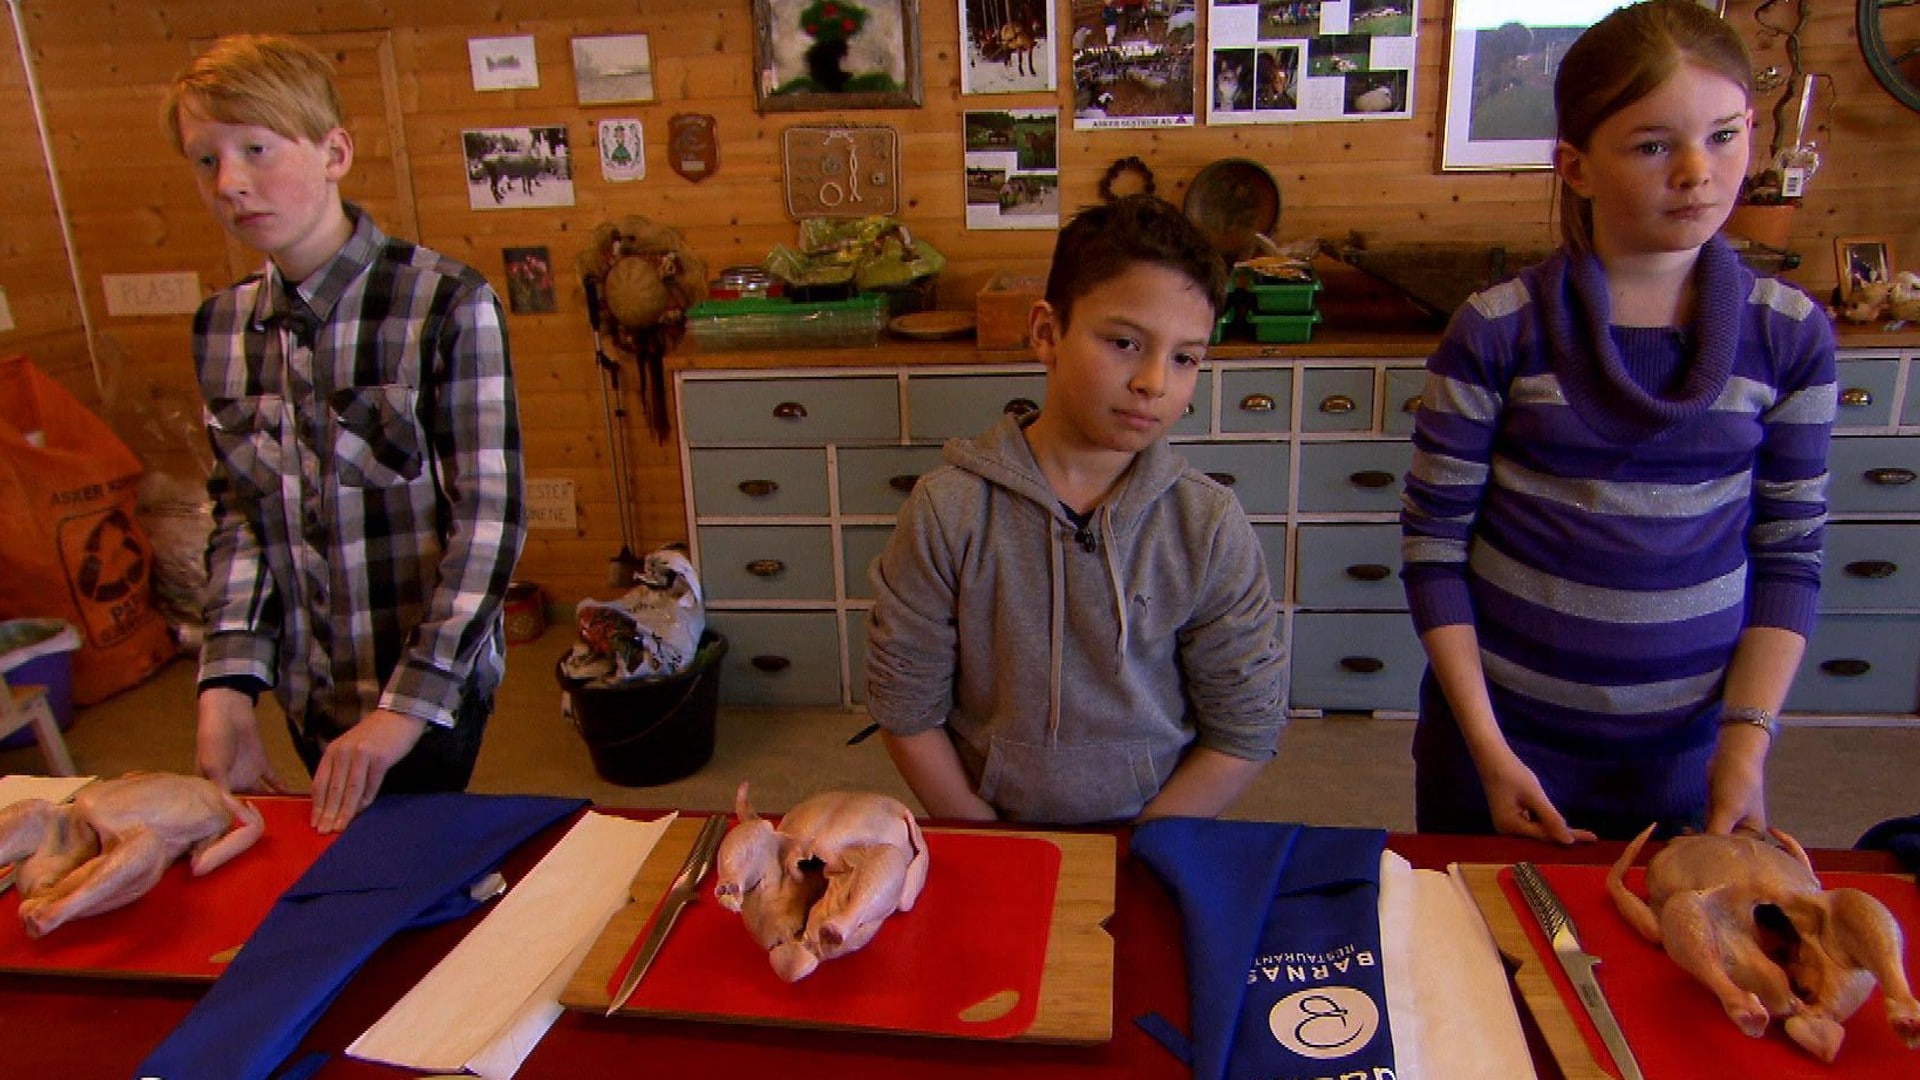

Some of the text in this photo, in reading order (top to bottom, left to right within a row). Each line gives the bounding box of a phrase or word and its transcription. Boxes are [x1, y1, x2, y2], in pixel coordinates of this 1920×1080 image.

[52, 484, 104, 505] ASKER
[1255, 943, 1355, 966] RESTAURANT
[1246, 950, 1376, 985] BARNAS
